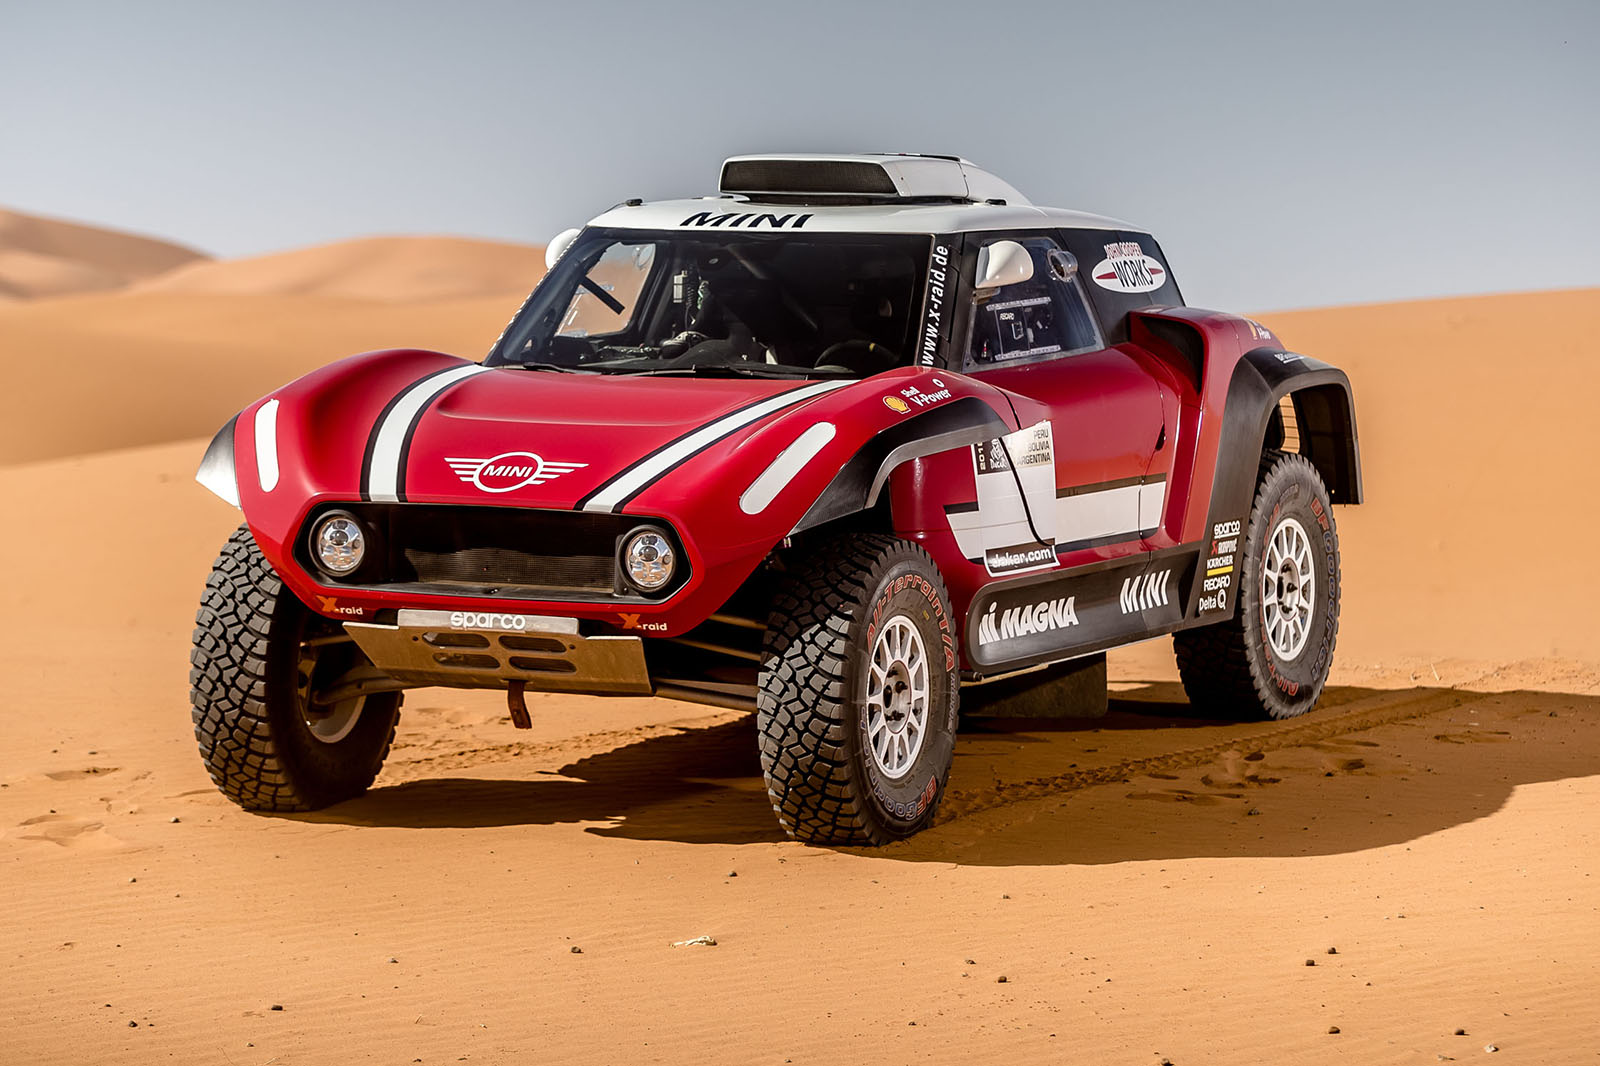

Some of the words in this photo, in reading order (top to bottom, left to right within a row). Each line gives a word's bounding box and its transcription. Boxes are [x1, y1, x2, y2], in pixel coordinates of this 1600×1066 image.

[680, 212, 815, 228] MINI
[1111, 259, 1154, 287] WORKS
[921, 245, 949, 366] www.x-raid.de
[909, 389, 952, 407] V-Power
[1033, 429, 1049, 440] PERU
[483, 465, 533, 478] MINI
[1213, 520, 1240, 536] sparco
[990, 548, 1052, 568] dakar.com
[1119, 569, 1171, 614] MINI
[1203, 575, 1231, 592] RECARO
[1217, 588, 1227, 610] Q
[450, 611, 526, 631] sparco
[1001, 596, 1079, 640] MAGNA
